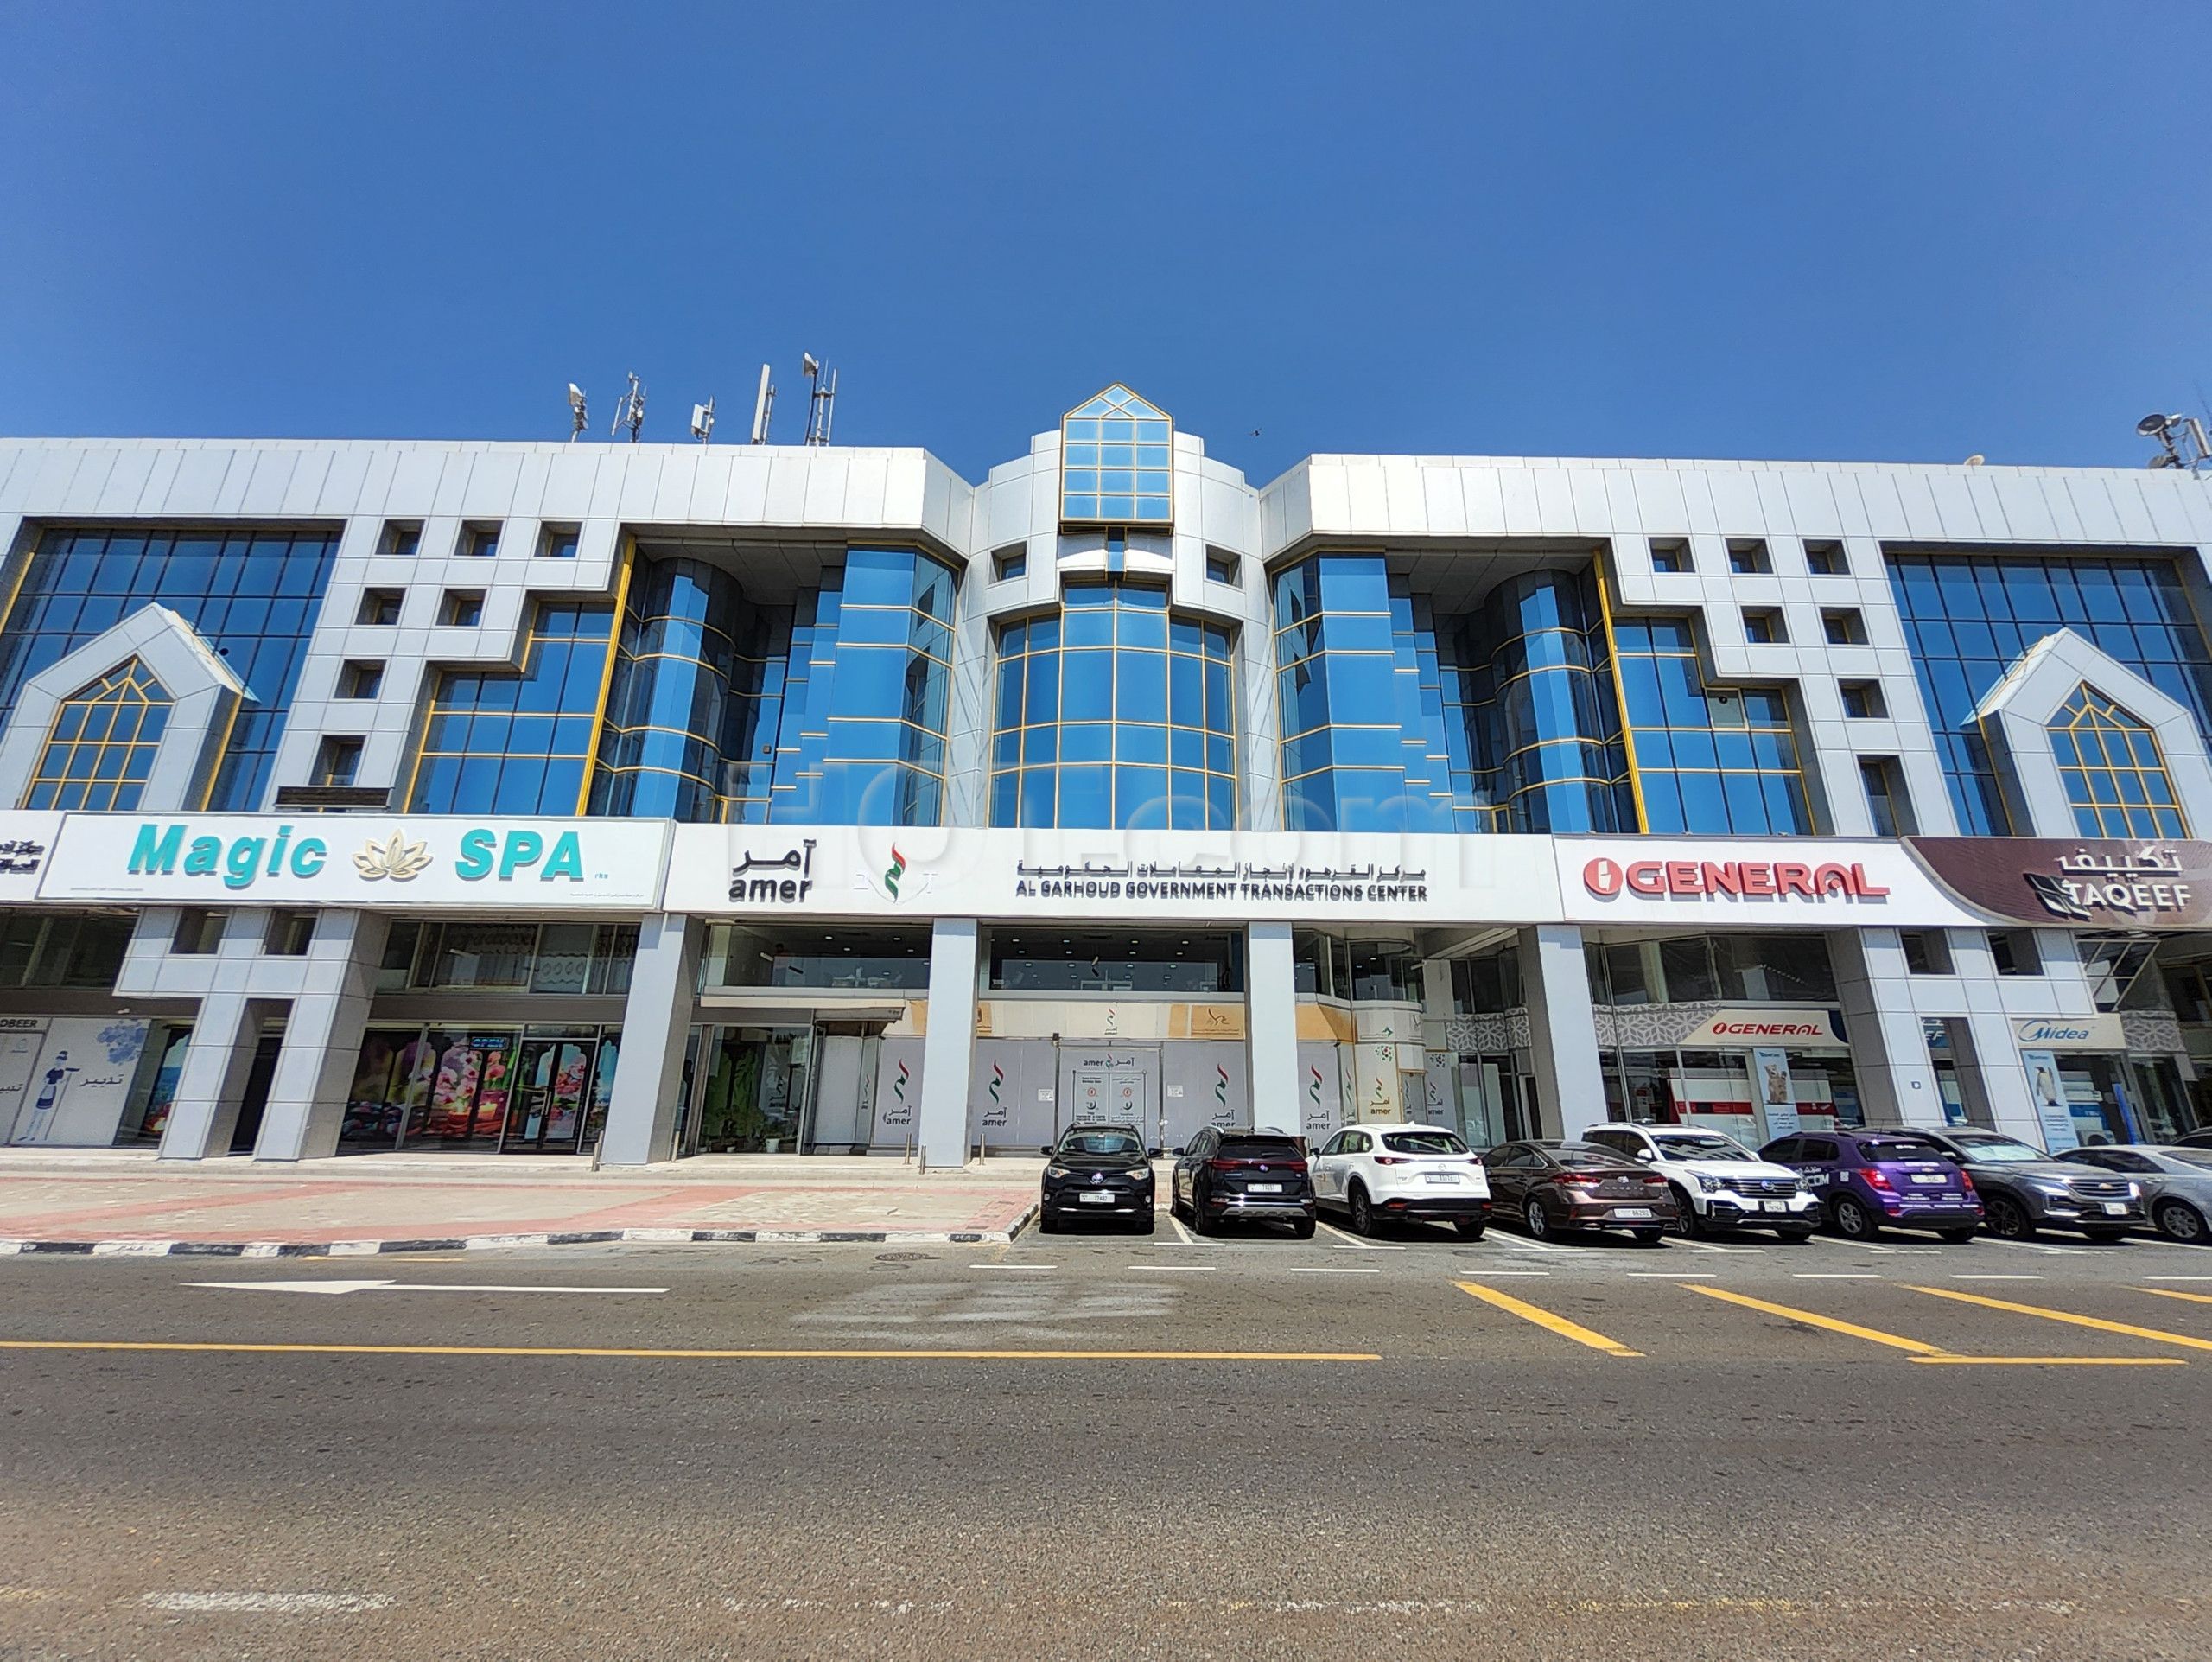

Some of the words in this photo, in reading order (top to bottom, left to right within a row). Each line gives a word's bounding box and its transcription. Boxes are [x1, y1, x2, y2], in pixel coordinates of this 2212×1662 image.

[127, 824, 327, 890] Magic
[455, 829, 584, 882] SPA
[733, 839, 817, 878] آمر
[2054, 845, 2183, 882] تكييف
[1017, 859, 1133, 879] الحكومية
[1137, 860, 1241, 880] المعاملات
[1299, 863, 1374, 882] القرهود
[1376, 864, 1426, 882] مركز
[728, 878, 813, 903] amer
[1016, 880, 1036, 897] AL
[1040, 881, 1121, 899] GARHOUD
[1125, 882, 1236, 900] GOVERNMENT
[1240, 883, 1363, 901] TRANSACTIONS
[1367, 884, 1428, 902] CENTER
[2062, 882, 2191, 912] TAQEEF
[2020, 1020, 2089, 1041] Midea
[982, 1118, 1007, 1127] amer
